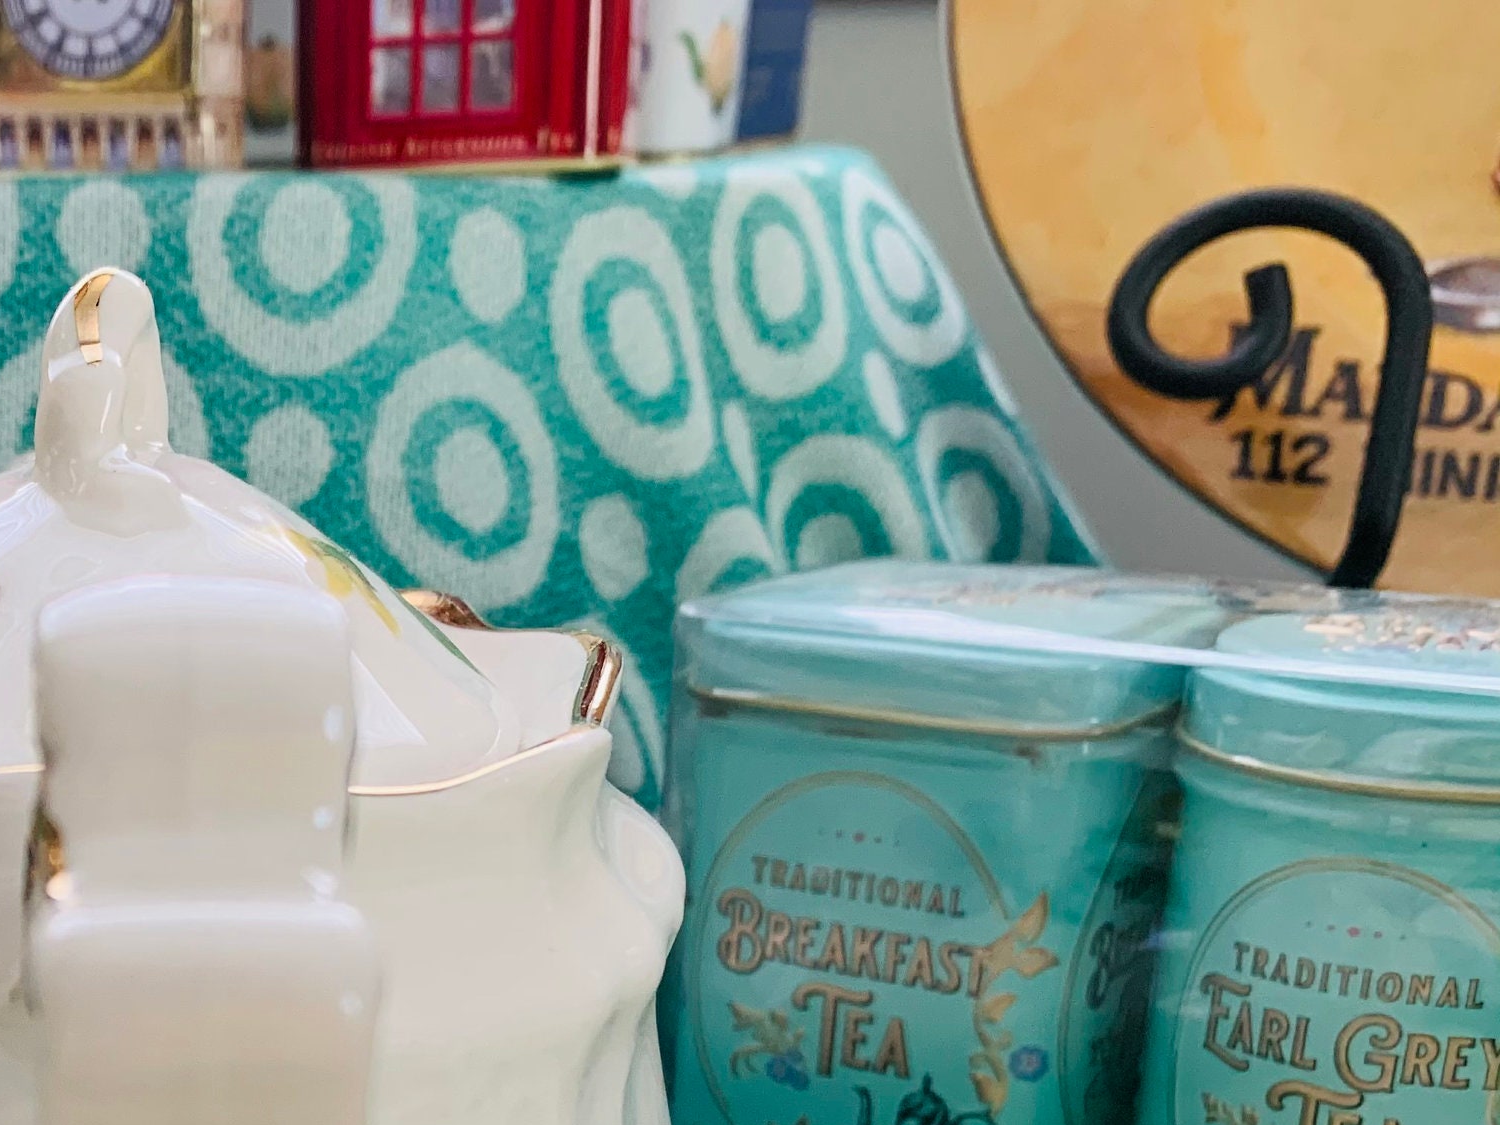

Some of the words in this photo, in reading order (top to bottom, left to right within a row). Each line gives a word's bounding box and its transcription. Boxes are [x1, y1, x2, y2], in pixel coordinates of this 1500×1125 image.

[1231, 430, 1330, 485] 112
[752, 855, 964, 918] TRADITIONAL
[717, 887, 990, 997] BREAKFAST
[1234, 941, 1484, 1009] TRADITIONAL
[791, 981, 910, 1079] TEA
[1201, 972, 1317, 1072] EARL
[1334, 1012, 1500, 1093] GREY
